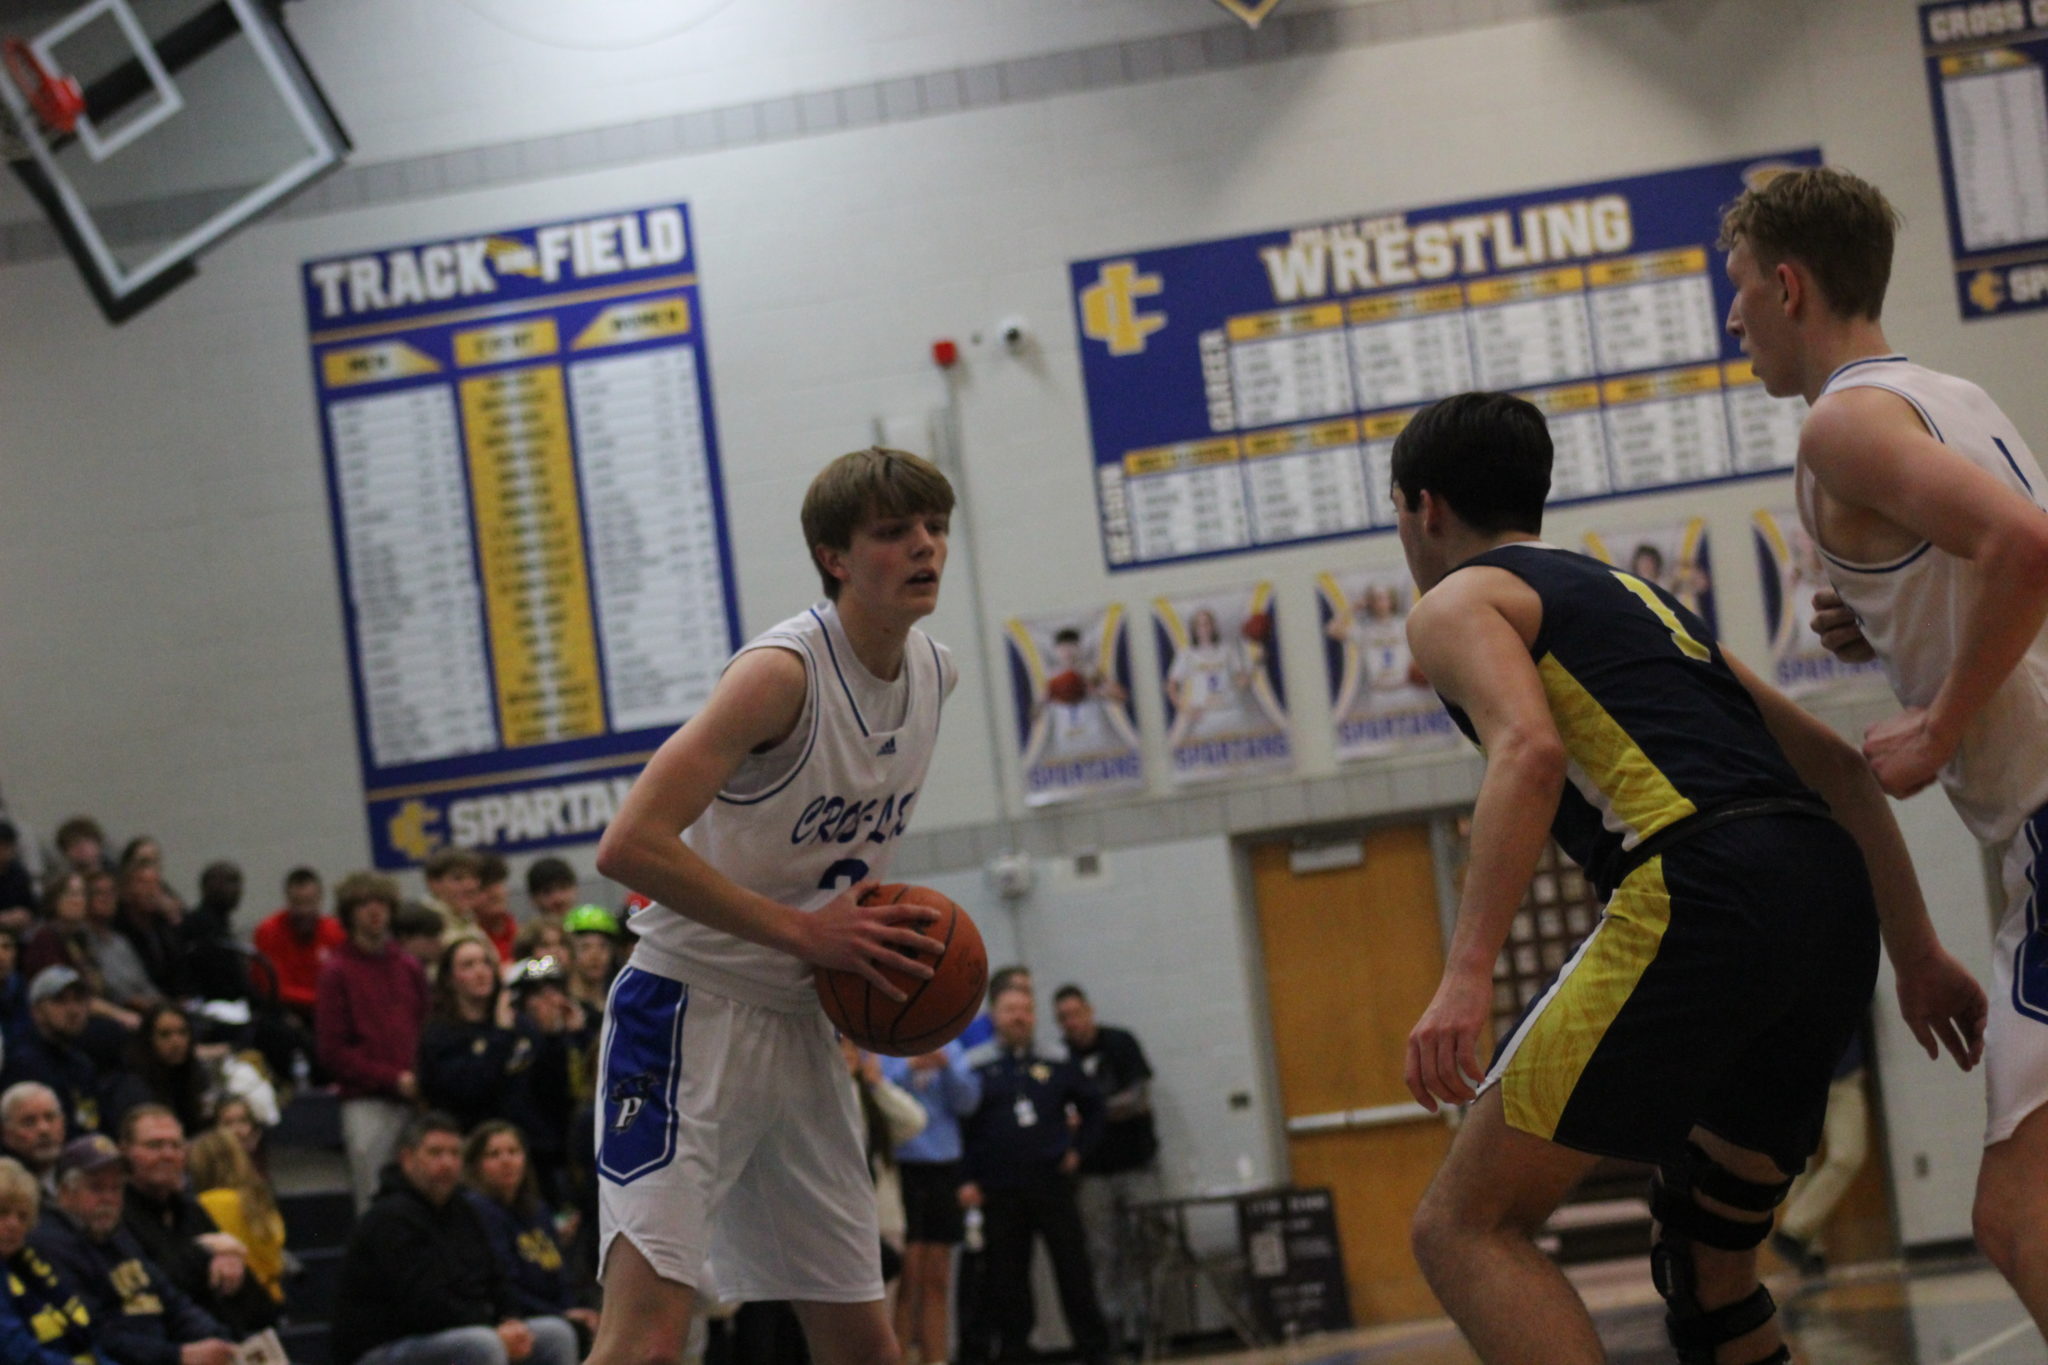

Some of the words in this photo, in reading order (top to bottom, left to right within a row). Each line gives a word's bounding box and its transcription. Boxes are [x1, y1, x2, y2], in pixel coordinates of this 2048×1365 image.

[312, 238, 497, 318] TRACK
[536, 207, 688, 283] FIELD
[1259, 194, 1634, 302] WRESTLING
